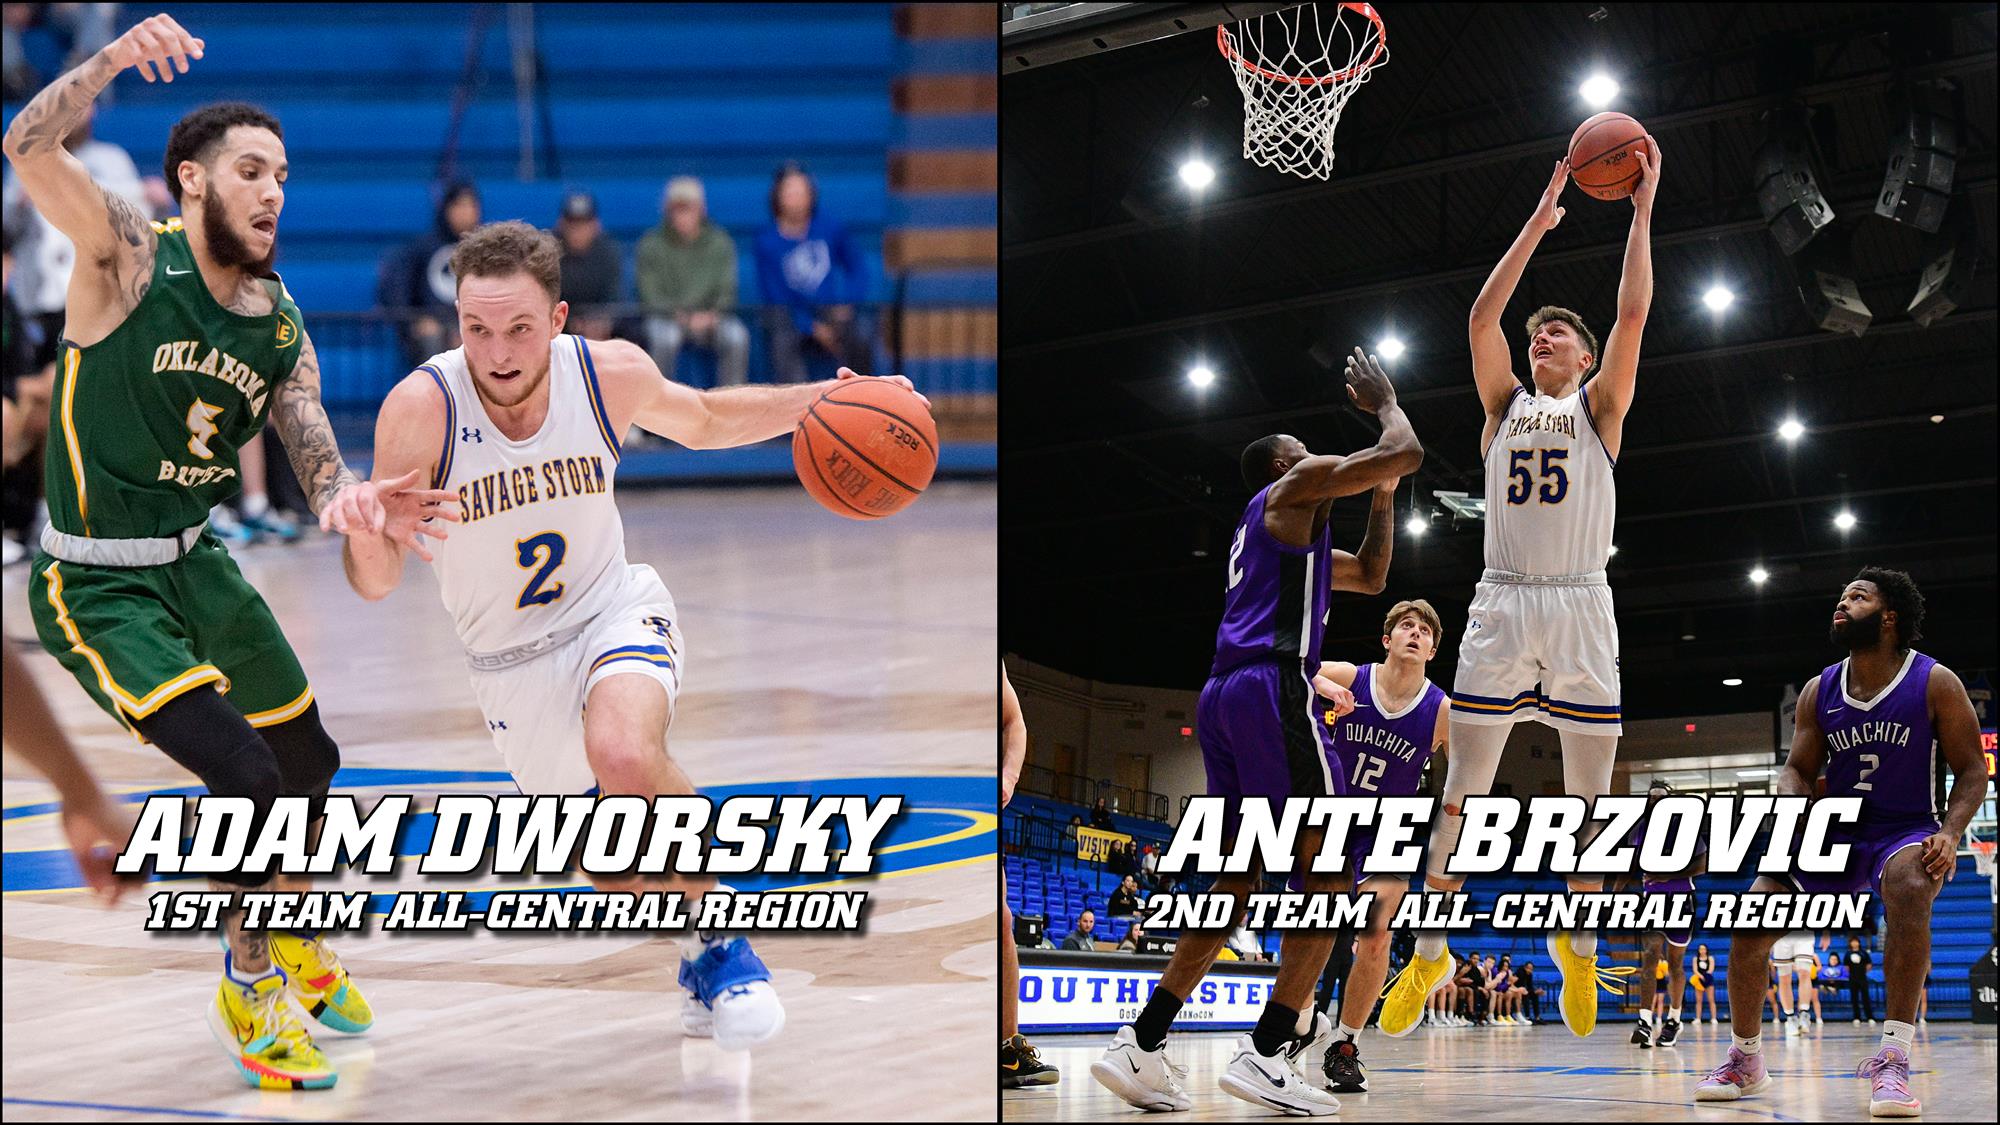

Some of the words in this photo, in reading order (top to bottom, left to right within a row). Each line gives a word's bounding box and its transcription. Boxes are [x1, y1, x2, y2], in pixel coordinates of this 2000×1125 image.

[186, 396, 225, 460] 5
[886, 422, 920, 451] ROCK
[458, 466, 540, 526] SAVAGE
[542, 455, 607, 500] STORM
[1507, 448, 1570, 507] 55
[513, 529, 569, 611] 2
[1346, 723, 1417, 763] OUACHITA
[1827, 721, 1911, 752] OUACHITA
[1351, 752, 1387, 791] 12
[1853, 753, 1880, 791] 2
